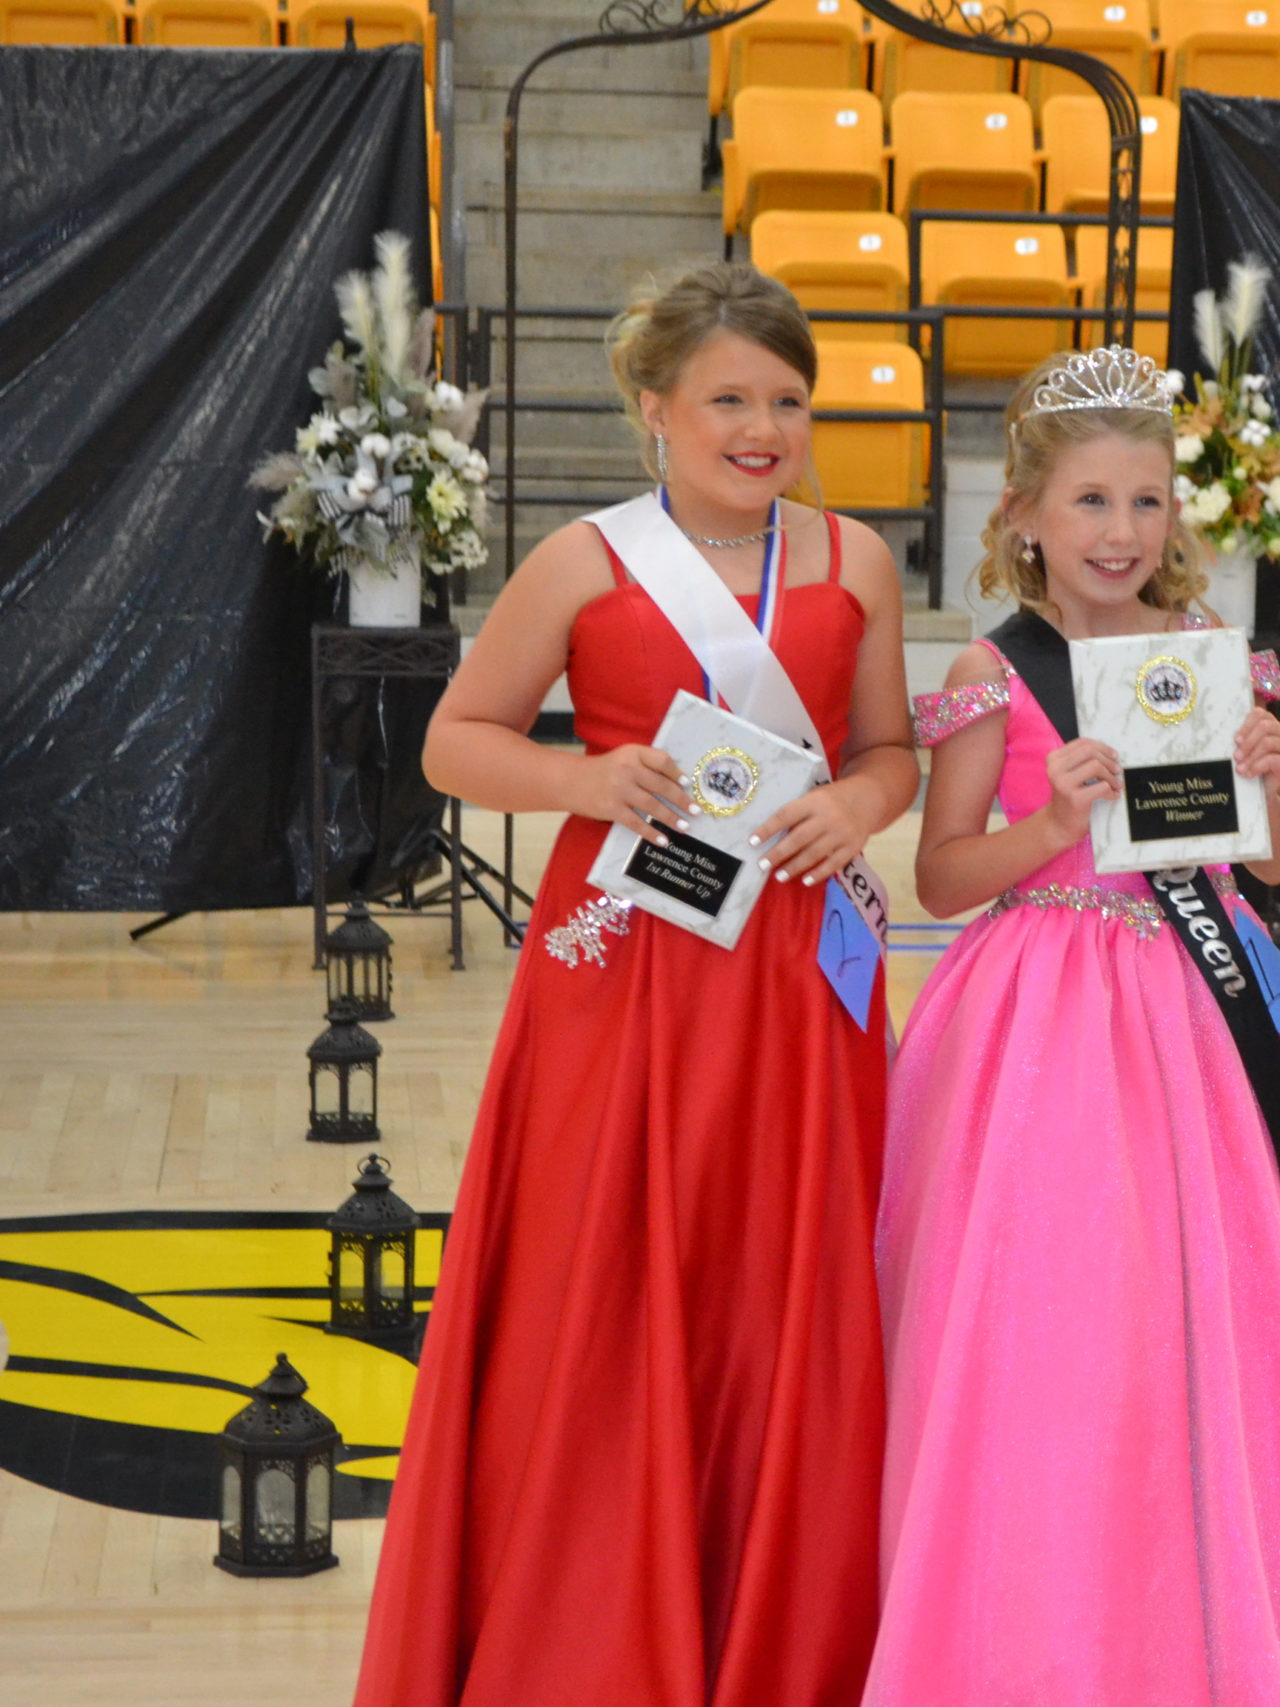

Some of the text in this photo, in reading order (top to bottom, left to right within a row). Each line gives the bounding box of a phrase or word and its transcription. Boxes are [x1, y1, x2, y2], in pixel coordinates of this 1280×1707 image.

[1147, 777, 1213, 794] Young Miss
[1134, 792, 1230, 811] Lawrence County
[1165, 809, 1204, 823] Winner
[644, 845, 724, 890] Lawrence County
[693, 853, 717, 872] Miss
[646, 861, 711, 899] 1st Runner Up
[826, 908, 861, 978] 2
